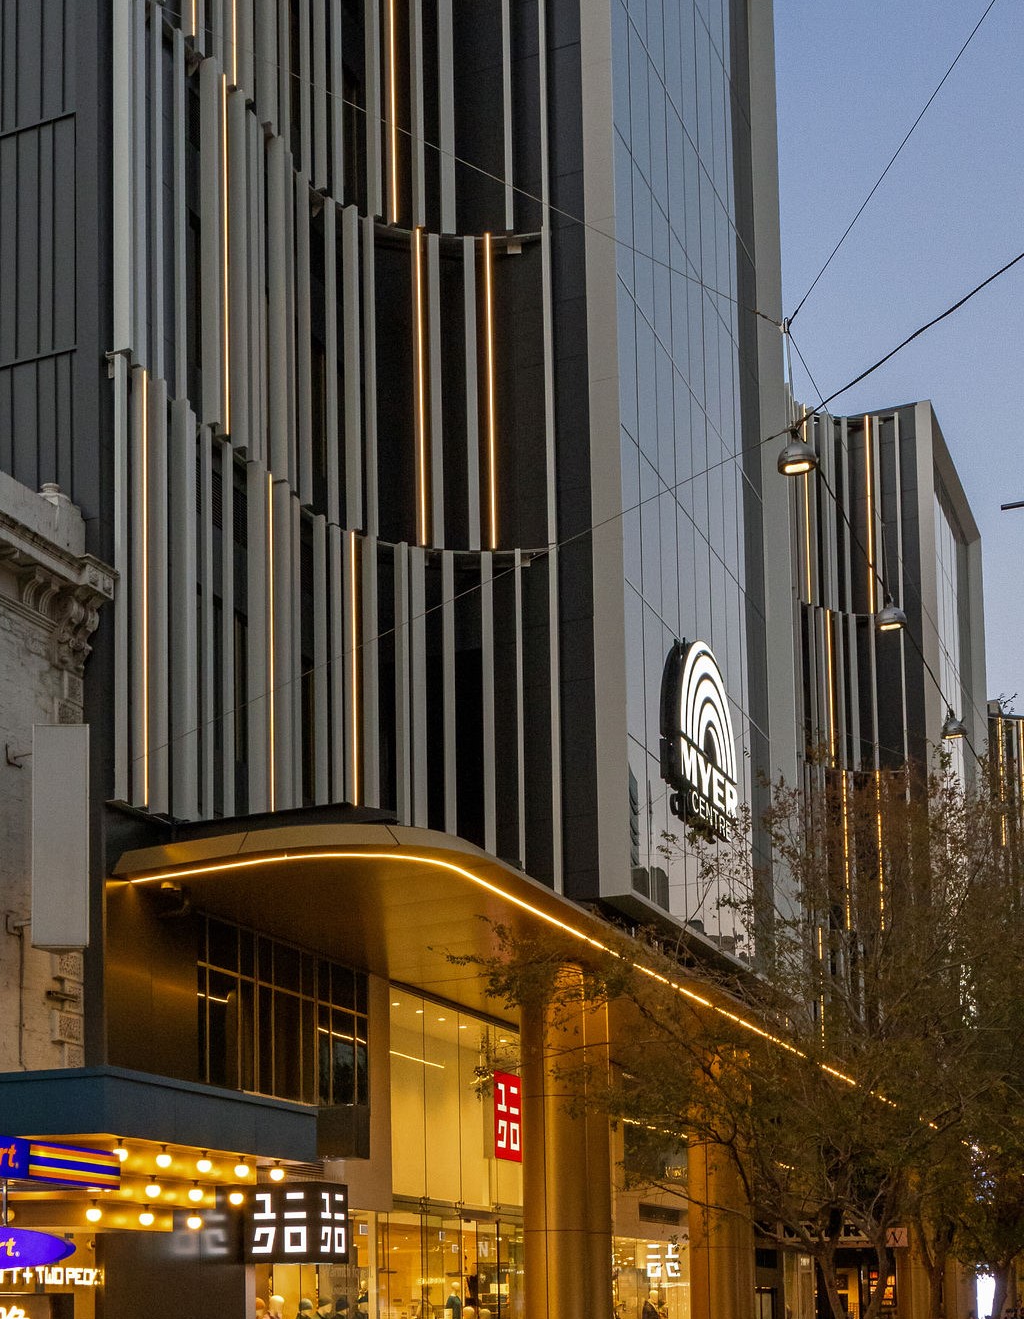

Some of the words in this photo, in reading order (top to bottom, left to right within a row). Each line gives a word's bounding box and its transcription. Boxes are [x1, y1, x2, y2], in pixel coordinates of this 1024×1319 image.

[681, 737, 737, 819] MYER
[692, 790, 731, 842] CENTRE
[35, 1267, 63, 1284] TWO
